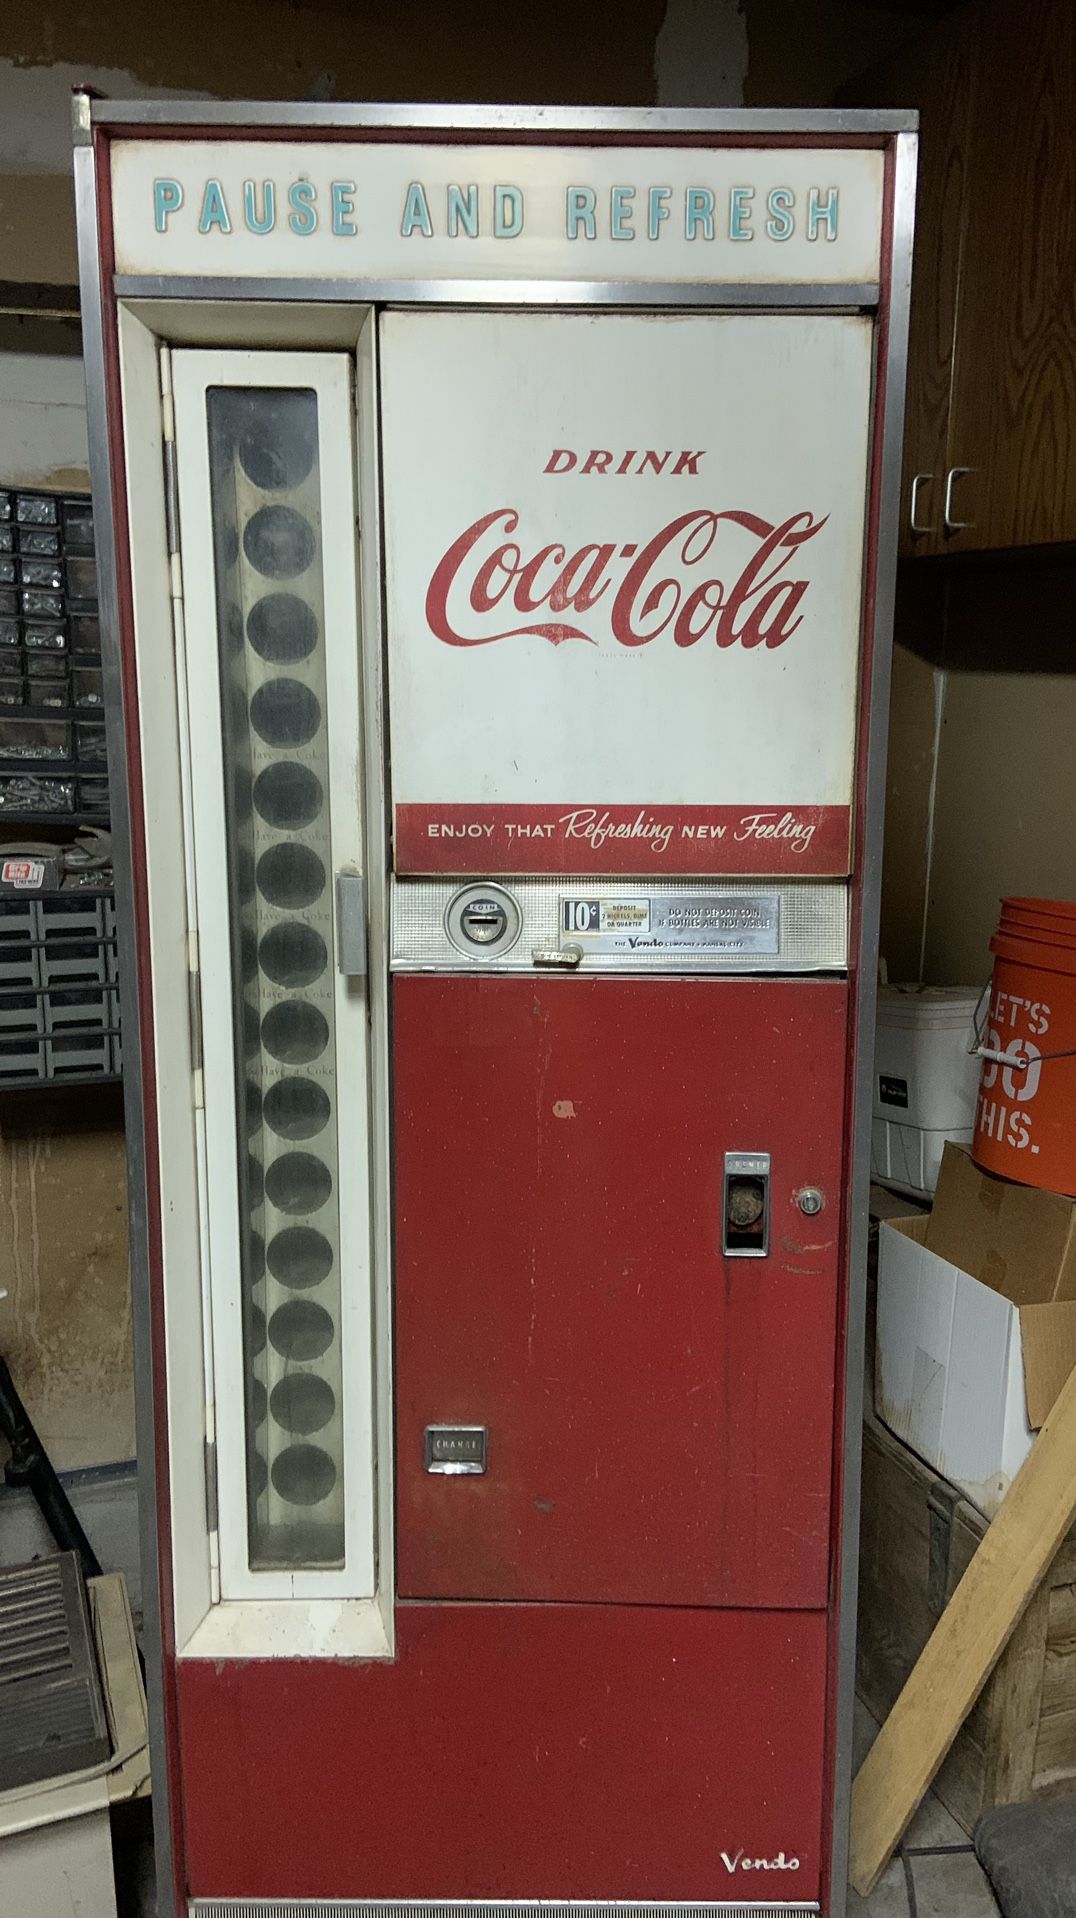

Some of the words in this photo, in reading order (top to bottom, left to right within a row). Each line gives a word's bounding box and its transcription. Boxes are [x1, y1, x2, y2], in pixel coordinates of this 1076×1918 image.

[153, 177, 358, 236] PAUSE
[400, 182, 524, 240] AND
[565, 184, 840, 242] REFRESH
[542, 448, 707, 476] DRINK
[424, 507, 832, 650] Coca-Cola
[427, 823, 496, 839] ENJOY
[504, 823, 555, 838] THAT
[558, 808, 675, 853] Refreshing
[681, 824, 728, 839] NEW
[733, 811, 817, 853] Feeling
[472, 903, 496, 911] COIN
[668, 907, 682, 918] DO
[685, 907, 702, 918] NOT
[705, 907, 738, 918] DEPOSIT
[740, 907, 761, 918] COIN
[658, 919, 667, 929] IF
[668, 919, 701, 929] BOTTLES
[703, 919, 719, 929] ARE
[721, 919, 739, 929] NOT
[741, 919, 770, 929] VISIBLE
[628, 936, 664, 950] Vendo
[990, 991, 1052, 1036] ET'S
[978, 1094, 1041, 1155] HIS.
[719, 1848, 801, 1874] Vendo
